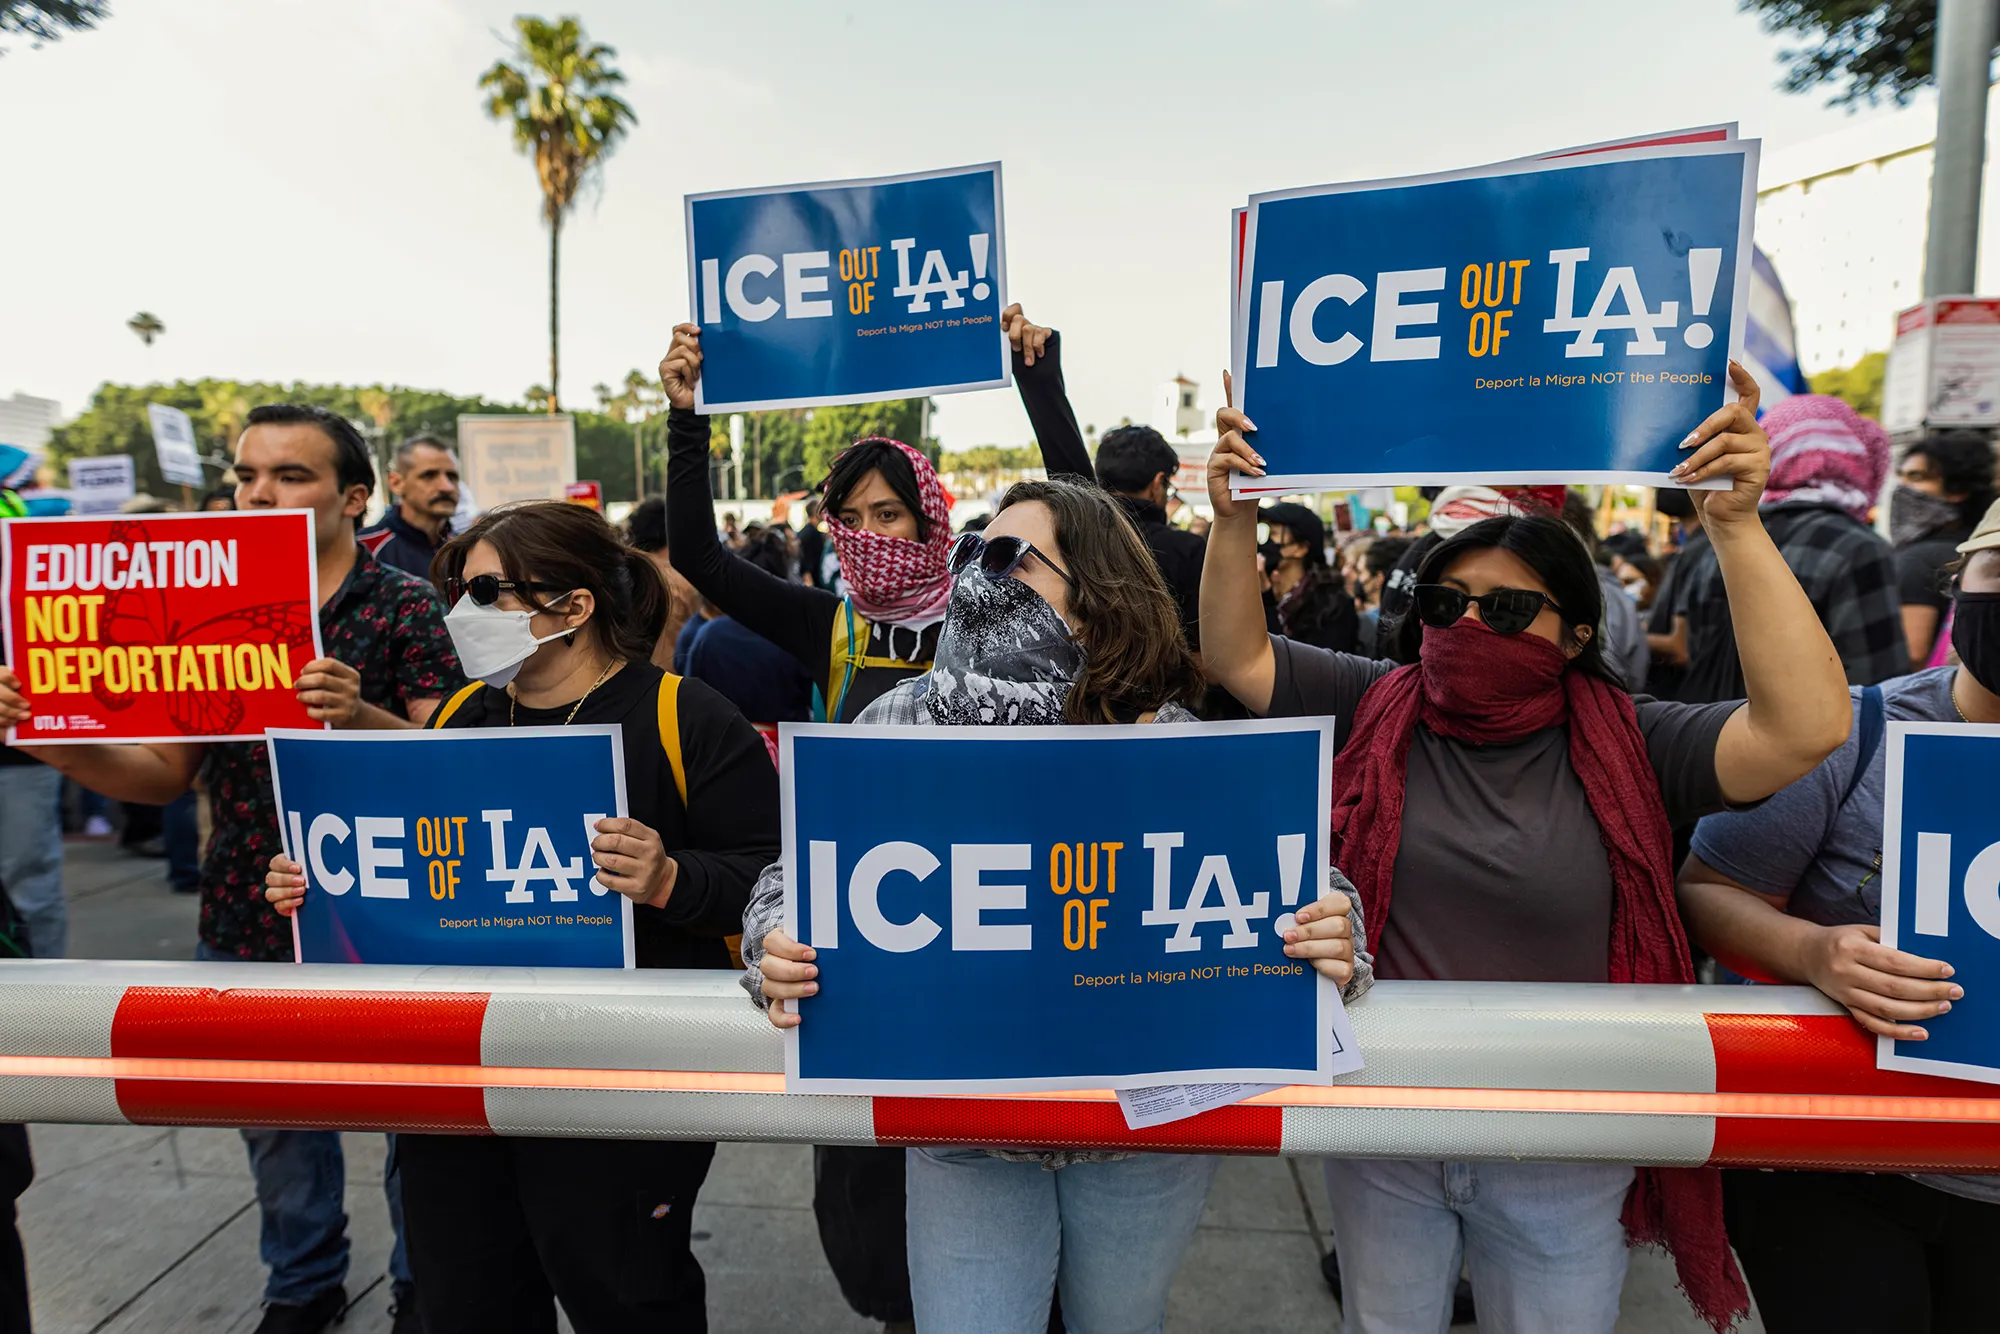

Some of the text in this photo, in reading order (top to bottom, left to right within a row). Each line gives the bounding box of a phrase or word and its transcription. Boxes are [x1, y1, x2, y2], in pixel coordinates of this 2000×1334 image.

[701, 233, 991, 324] ICE OUT OF LA!
[857, 328, 887, 337] Deport
[899, 323, 922, 333] Migra
[925, 320, 944, 329] NOT
[963, 315, 992, 324] People
[1255, 247, 1723, 368] ICE OUT OF LA!
[1476, 371, 1712, 390] Deport la Migra NOT the People
[25, 539, 238, 591] EDUCATION
[25, 595, 105, 643] NOT
[27, 644, 293, 694] DEPORTATION
[34, 715, 66, 730] UTLA
[288, 810, 409, 899] ICE
[416, 817, 468, 857] OUT
[428, 860, 461, 900] OF
[809, 832, 1306, 954] ICE OUT OF LA!
[440, 915, 612, 929] Deport la Migra NOT the People
[1074, 963, 1303, 987] Deport la Migra NOT the People
